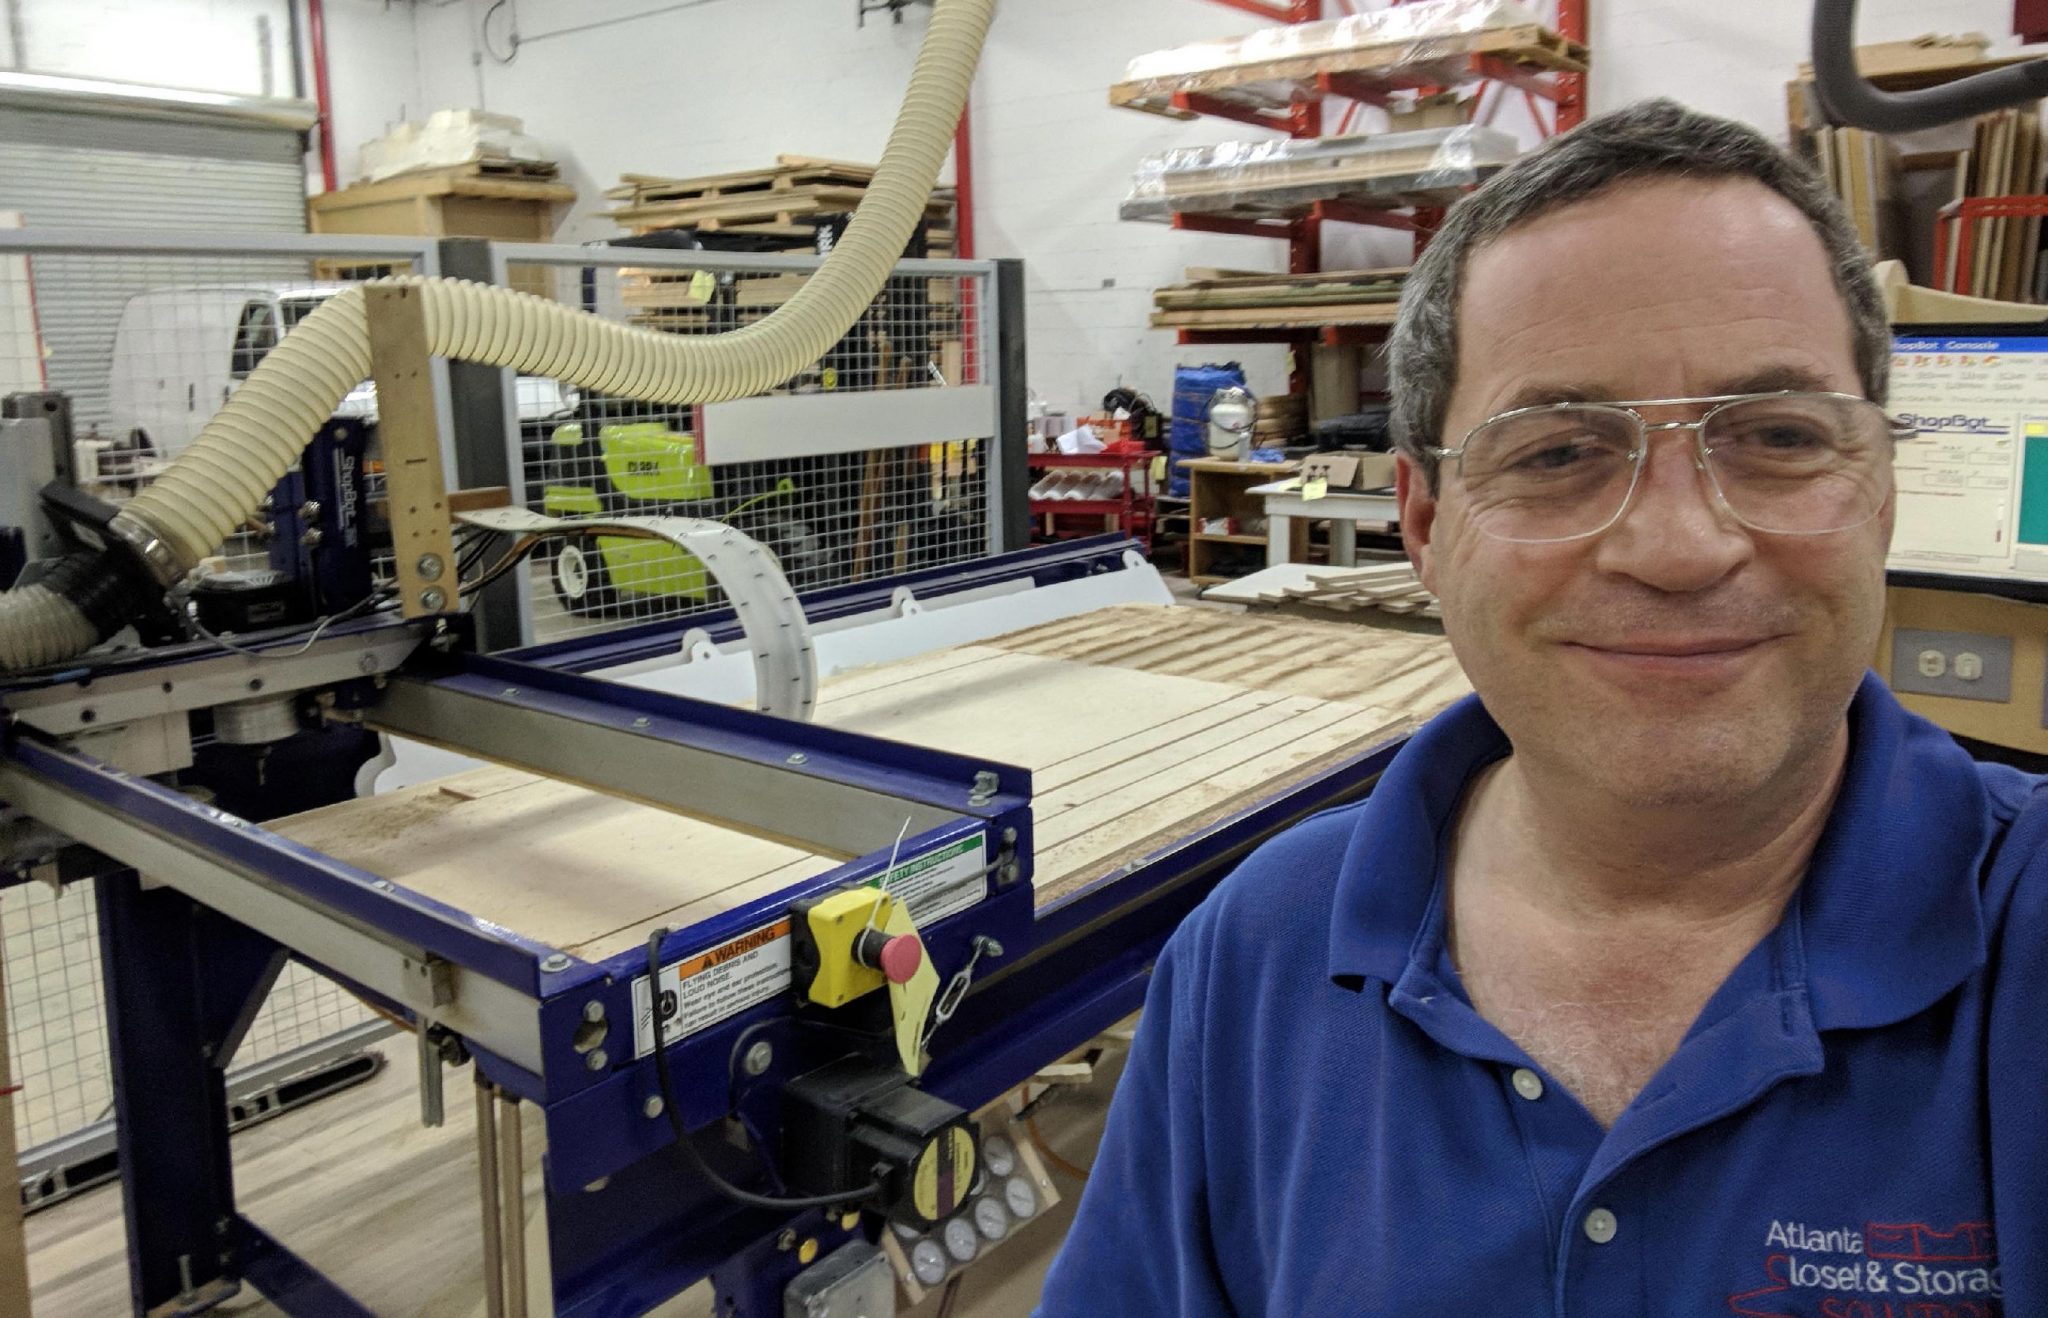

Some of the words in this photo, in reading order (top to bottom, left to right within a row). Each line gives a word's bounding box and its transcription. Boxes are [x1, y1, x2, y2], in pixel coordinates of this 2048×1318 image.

[1897, 413, 1990, 429] ShopBot
[341, 455, 358, 523] ShopBot
[715, 927, 776, 960] WARNING
[683, 968, 711, 989] FLYING
[742, 951, 759, 963] AND
[683, 984, 706, 1000] LOUD
[1765, 1219, 1863, 1254] Atlanta
[1866, 1261, 1889, 1292] &
